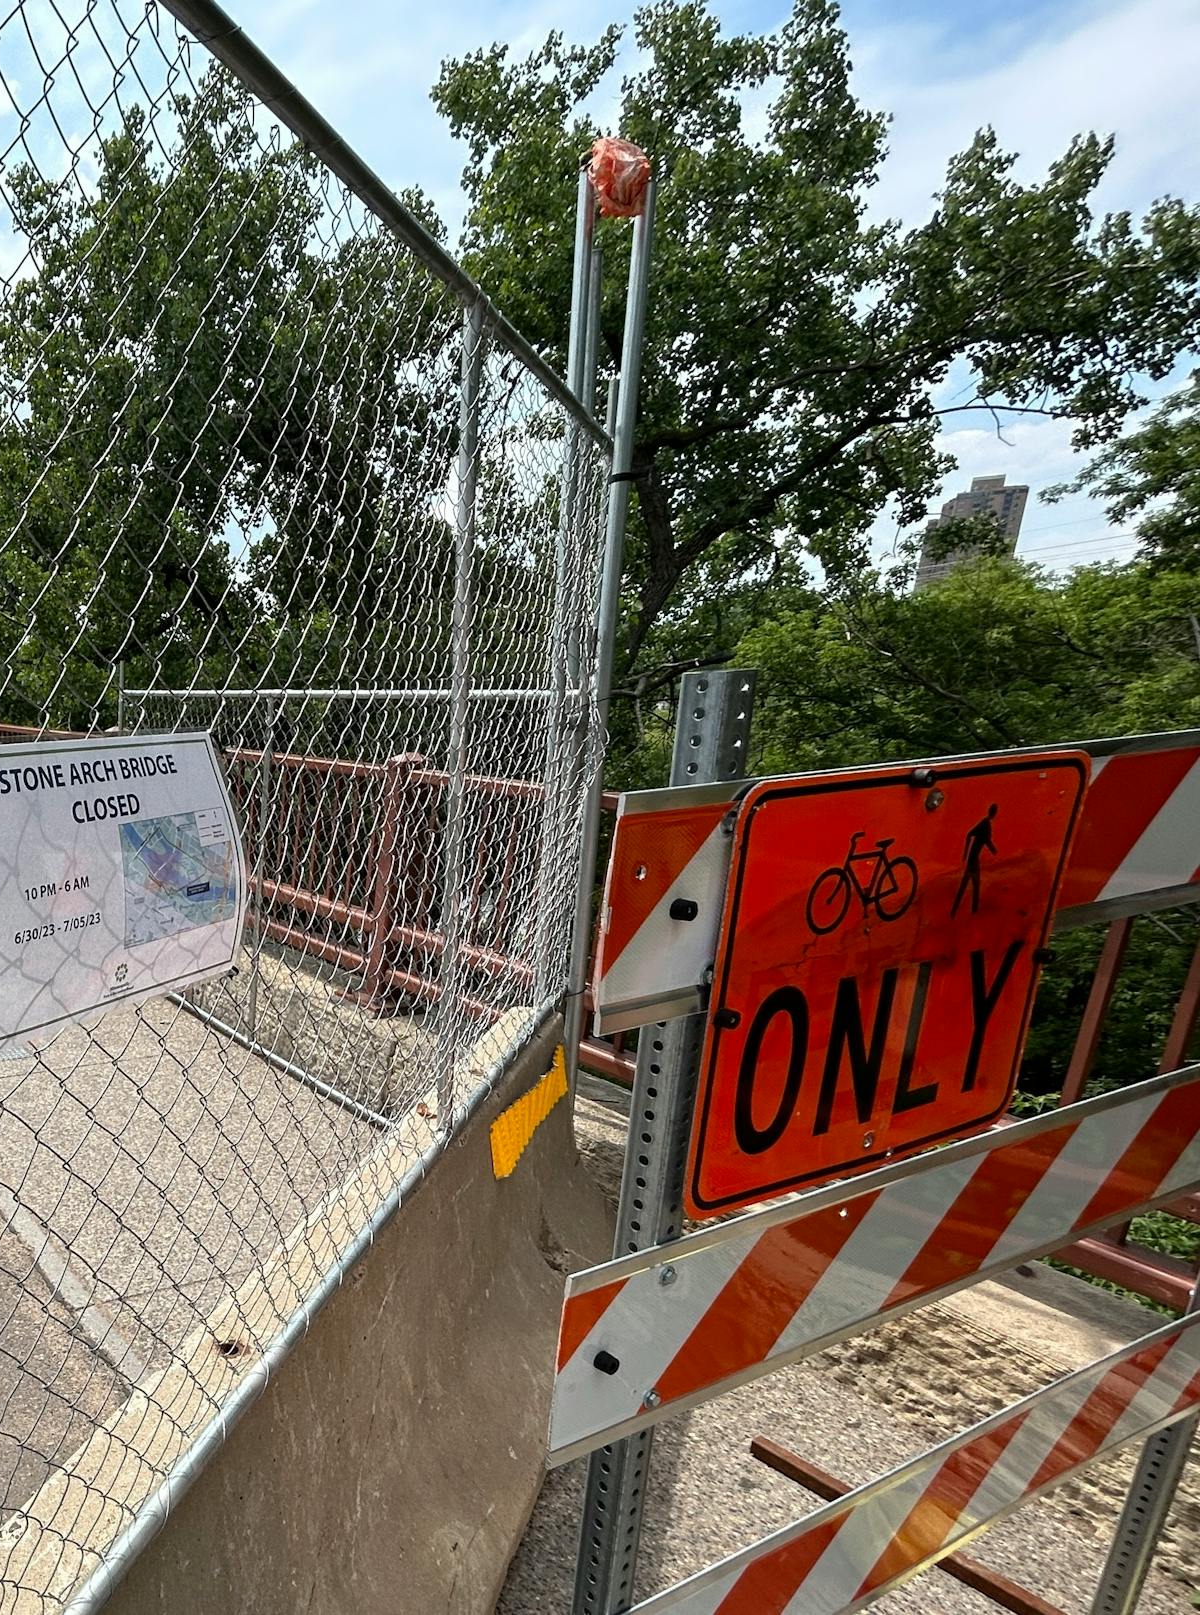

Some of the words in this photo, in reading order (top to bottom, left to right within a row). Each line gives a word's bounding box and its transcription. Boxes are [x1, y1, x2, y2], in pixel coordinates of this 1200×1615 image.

[70, 759, 118, 786] ARCH
[118, 754, 178, 780] BRIDGE
[72, 793, 140, 824] CLOSED
[24, 887, 38, 901] 10
[40, 883, 57, 898] PM
[64, 880, 71, 892] 6
[73, 876, 90, 890] AM
[14, 923, 55, 945] 6/30/23
[63, 912, 101, 933] 7/05/23
[733, 940, 1027, 1156] ONLY
